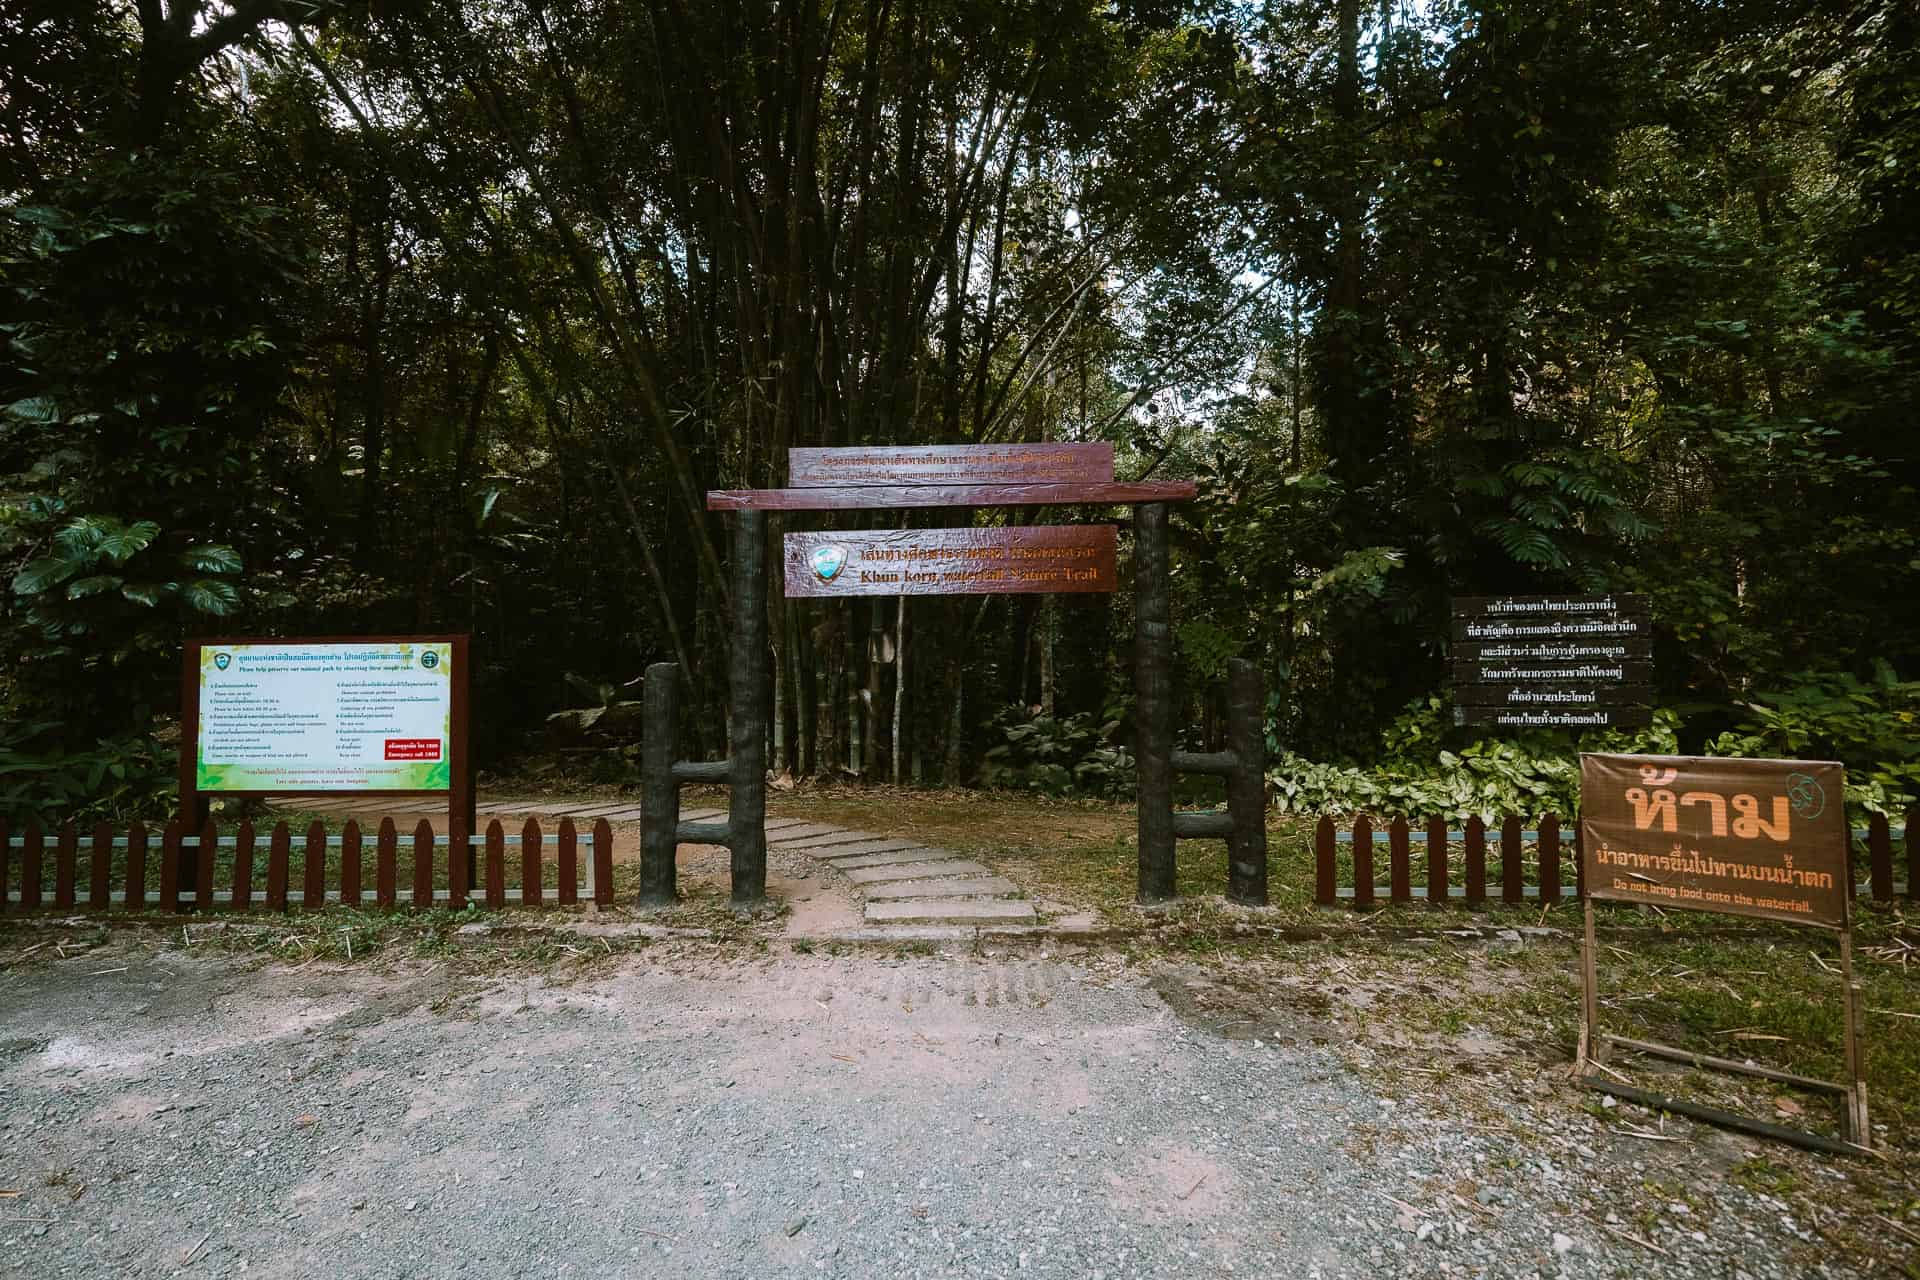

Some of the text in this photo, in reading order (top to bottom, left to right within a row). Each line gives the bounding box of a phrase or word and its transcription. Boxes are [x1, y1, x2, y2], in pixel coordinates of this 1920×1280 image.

[860, 570, 899, 583] Khun
[1010, 566, 1058, 582] Nature
[1063, 565, 1098, 582] Trail
[1625, 763, 1791, 842] ห้าม
[1596, 843, 1833, 889] นำอาหารขึ้นไปทานบนน้ำตก
[1612, 878, 1814, 913] Do not bring food onto the waterfall.
